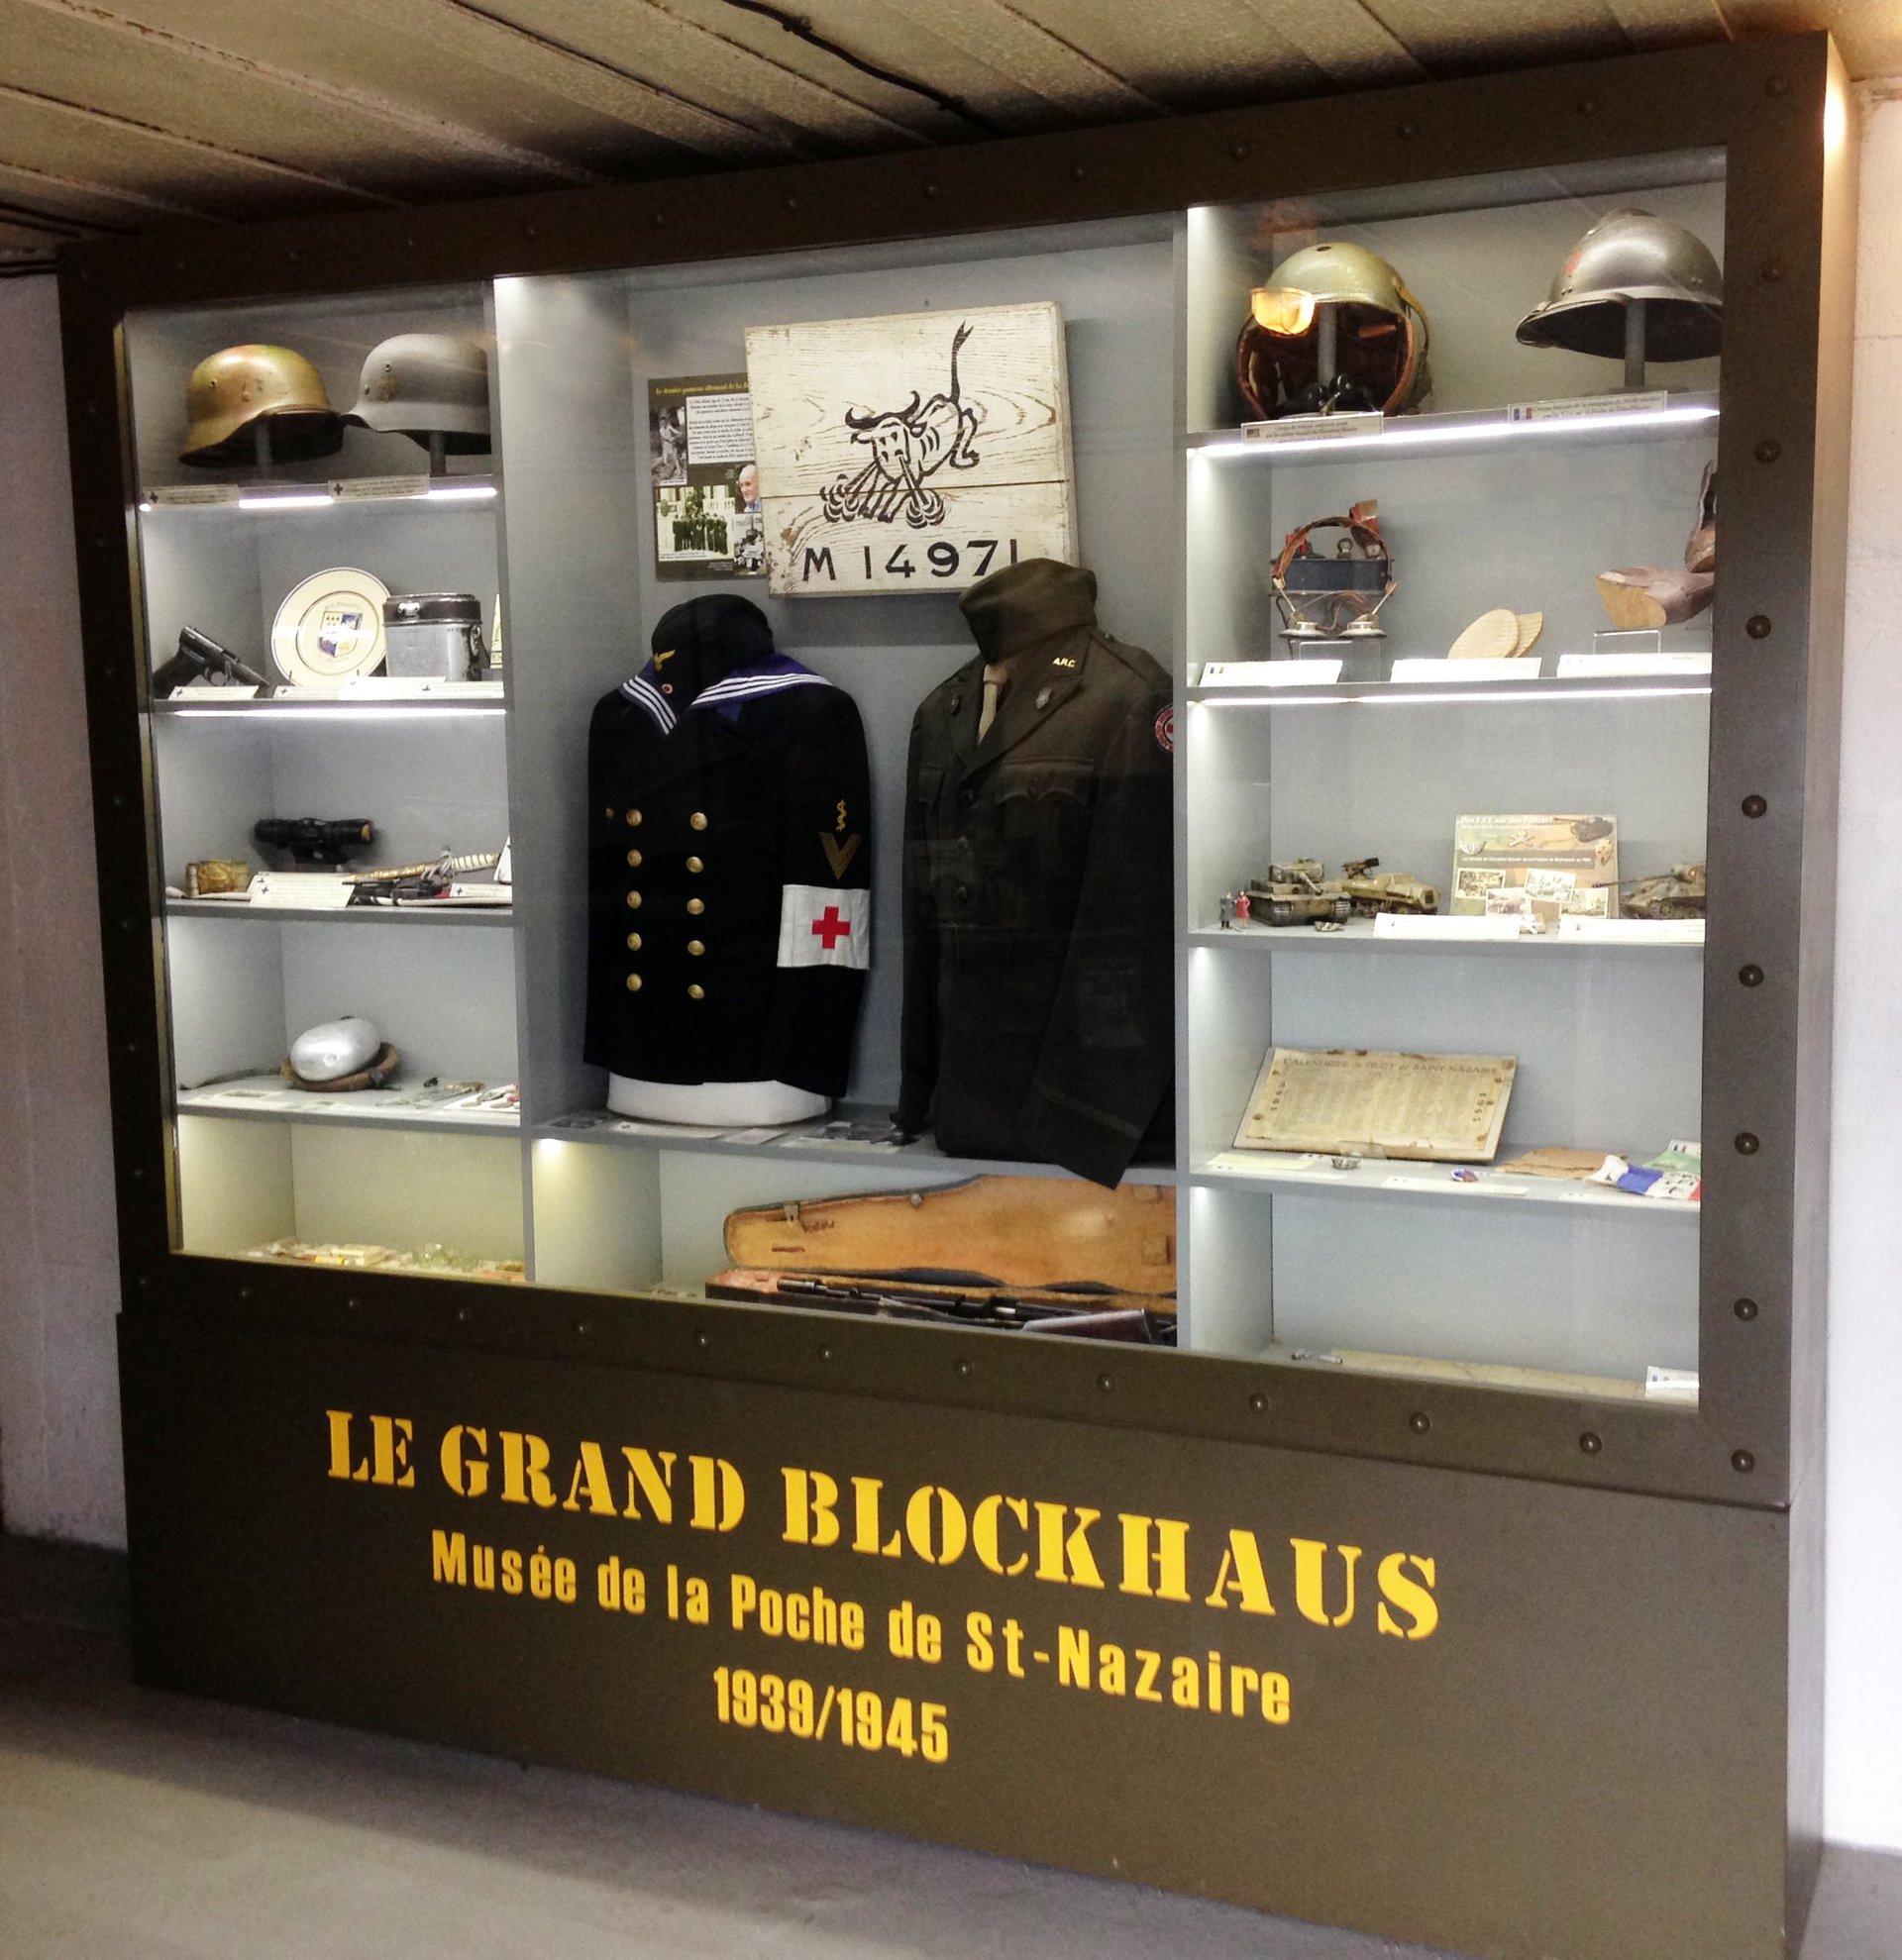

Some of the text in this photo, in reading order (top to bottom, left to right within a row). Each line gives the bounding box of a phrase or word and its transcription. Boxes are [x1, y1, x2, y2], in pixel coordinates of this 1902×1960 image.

[803, 539, 1017, 581] M 14971
[1052, 657, 1076, 669] ARC
[326, 1409, 1441, 1642] LE GRAND BLOCKHAUS
[432, 1529, 1294, 1727] Musée de la Poche de St-Nazaire
[712, 1665, 952, 1766] 1939/1945
